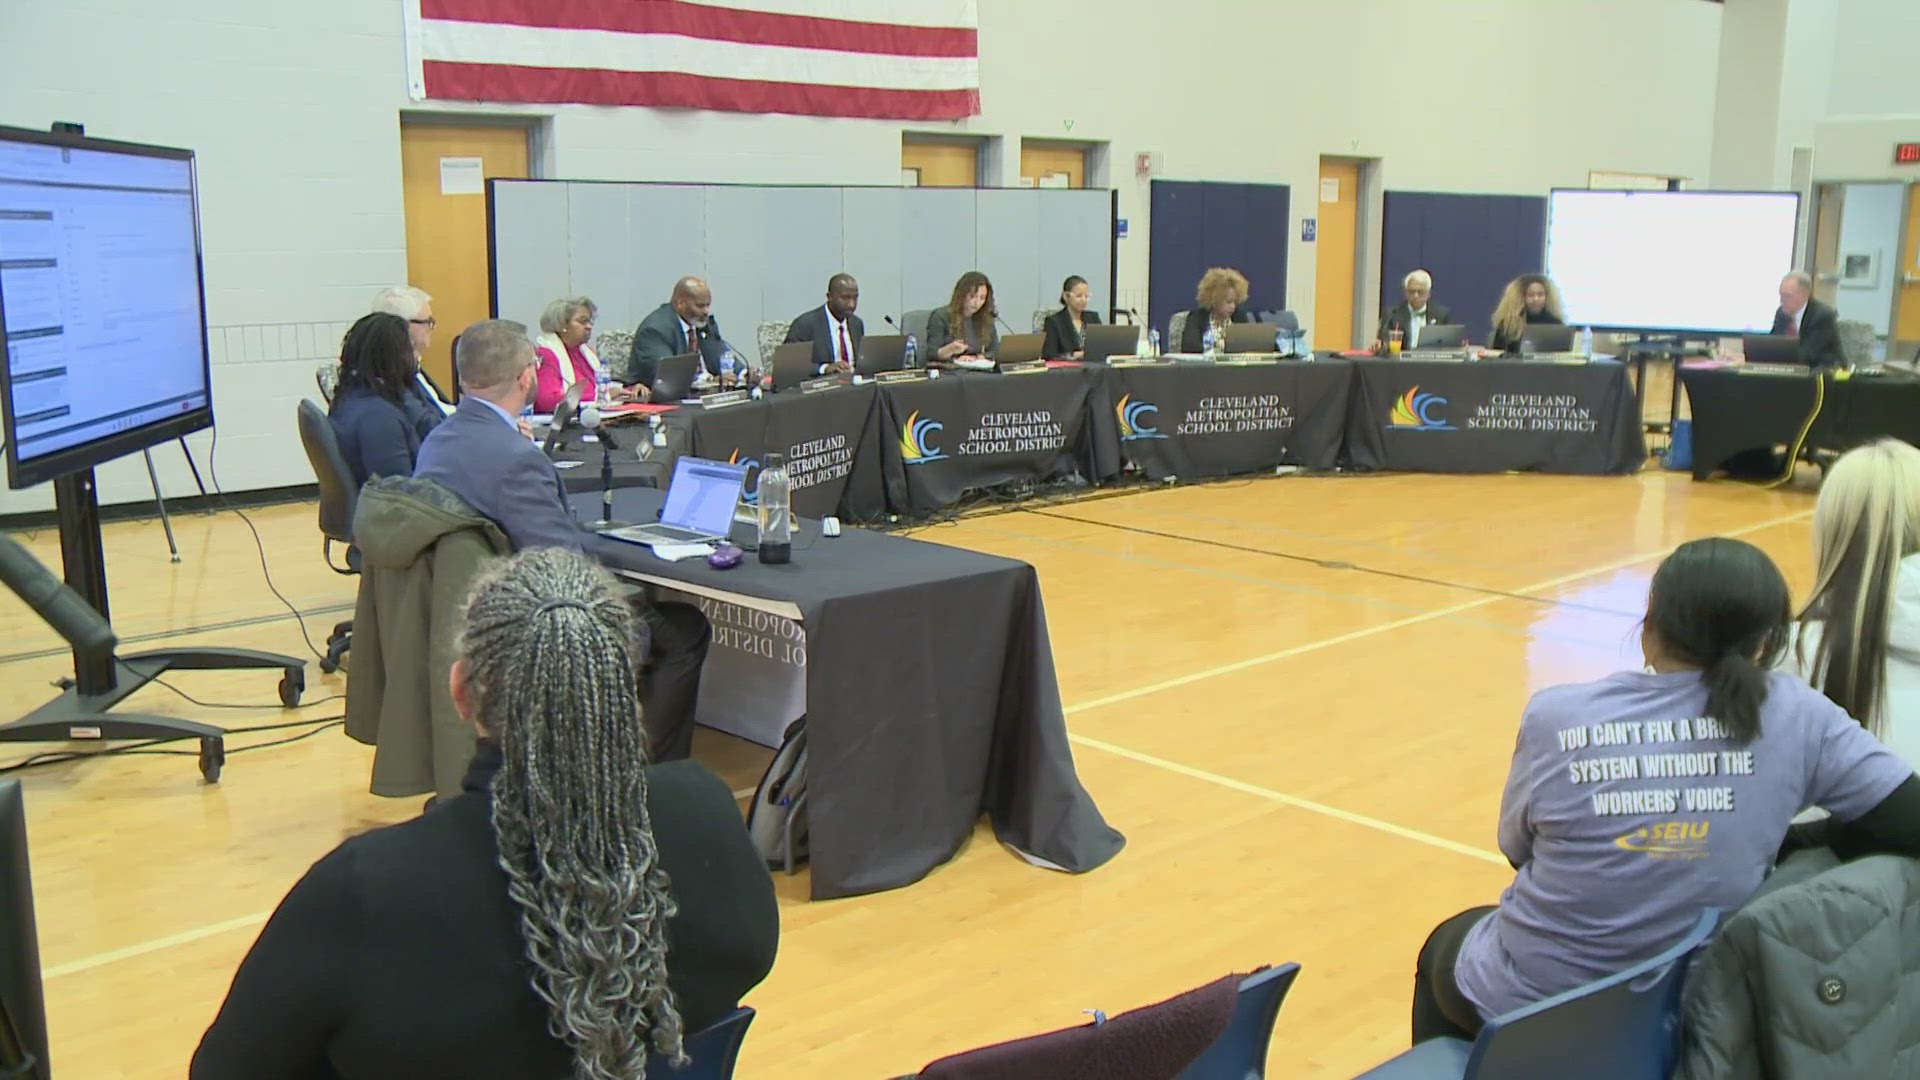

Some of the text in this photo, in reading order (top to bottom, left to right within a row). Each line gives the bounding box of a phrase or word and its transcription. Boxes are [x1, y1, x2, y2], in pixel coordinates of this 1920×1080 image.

[1200, 395, 1279, 409] CLEVELAND
[1492, 394, 1577, 407] CLEVELAND
[981, 411, 1051, 426] CLEVELAND
[1186, 407, 1290, 423] METROPOLITAN
[1477, 405, 1590, 420] METROPOLITAN
[968, 423, 1062, 441] METROPOLITAN
[1176, 417, 1294, 435] SCHOOL DISTRICT
[1468, 417, 1598, 432] SCHOOL DISTRICT
[790, 435, 845, 458] CLEVELAND
[958, 435, 1067, 455] SCHOOL DISTRICT
[790, 471, 815, 490] HOOL
[1558, 717, 1735, 751] YOU CAN'T FIX A BRO
[1569, 751, 1754, 784] SYSTEM WITHOUT THE
[1593, 787, 1734, 816] WORKERS' VOICE
[1652, 821, 1709, 839] SEIU
